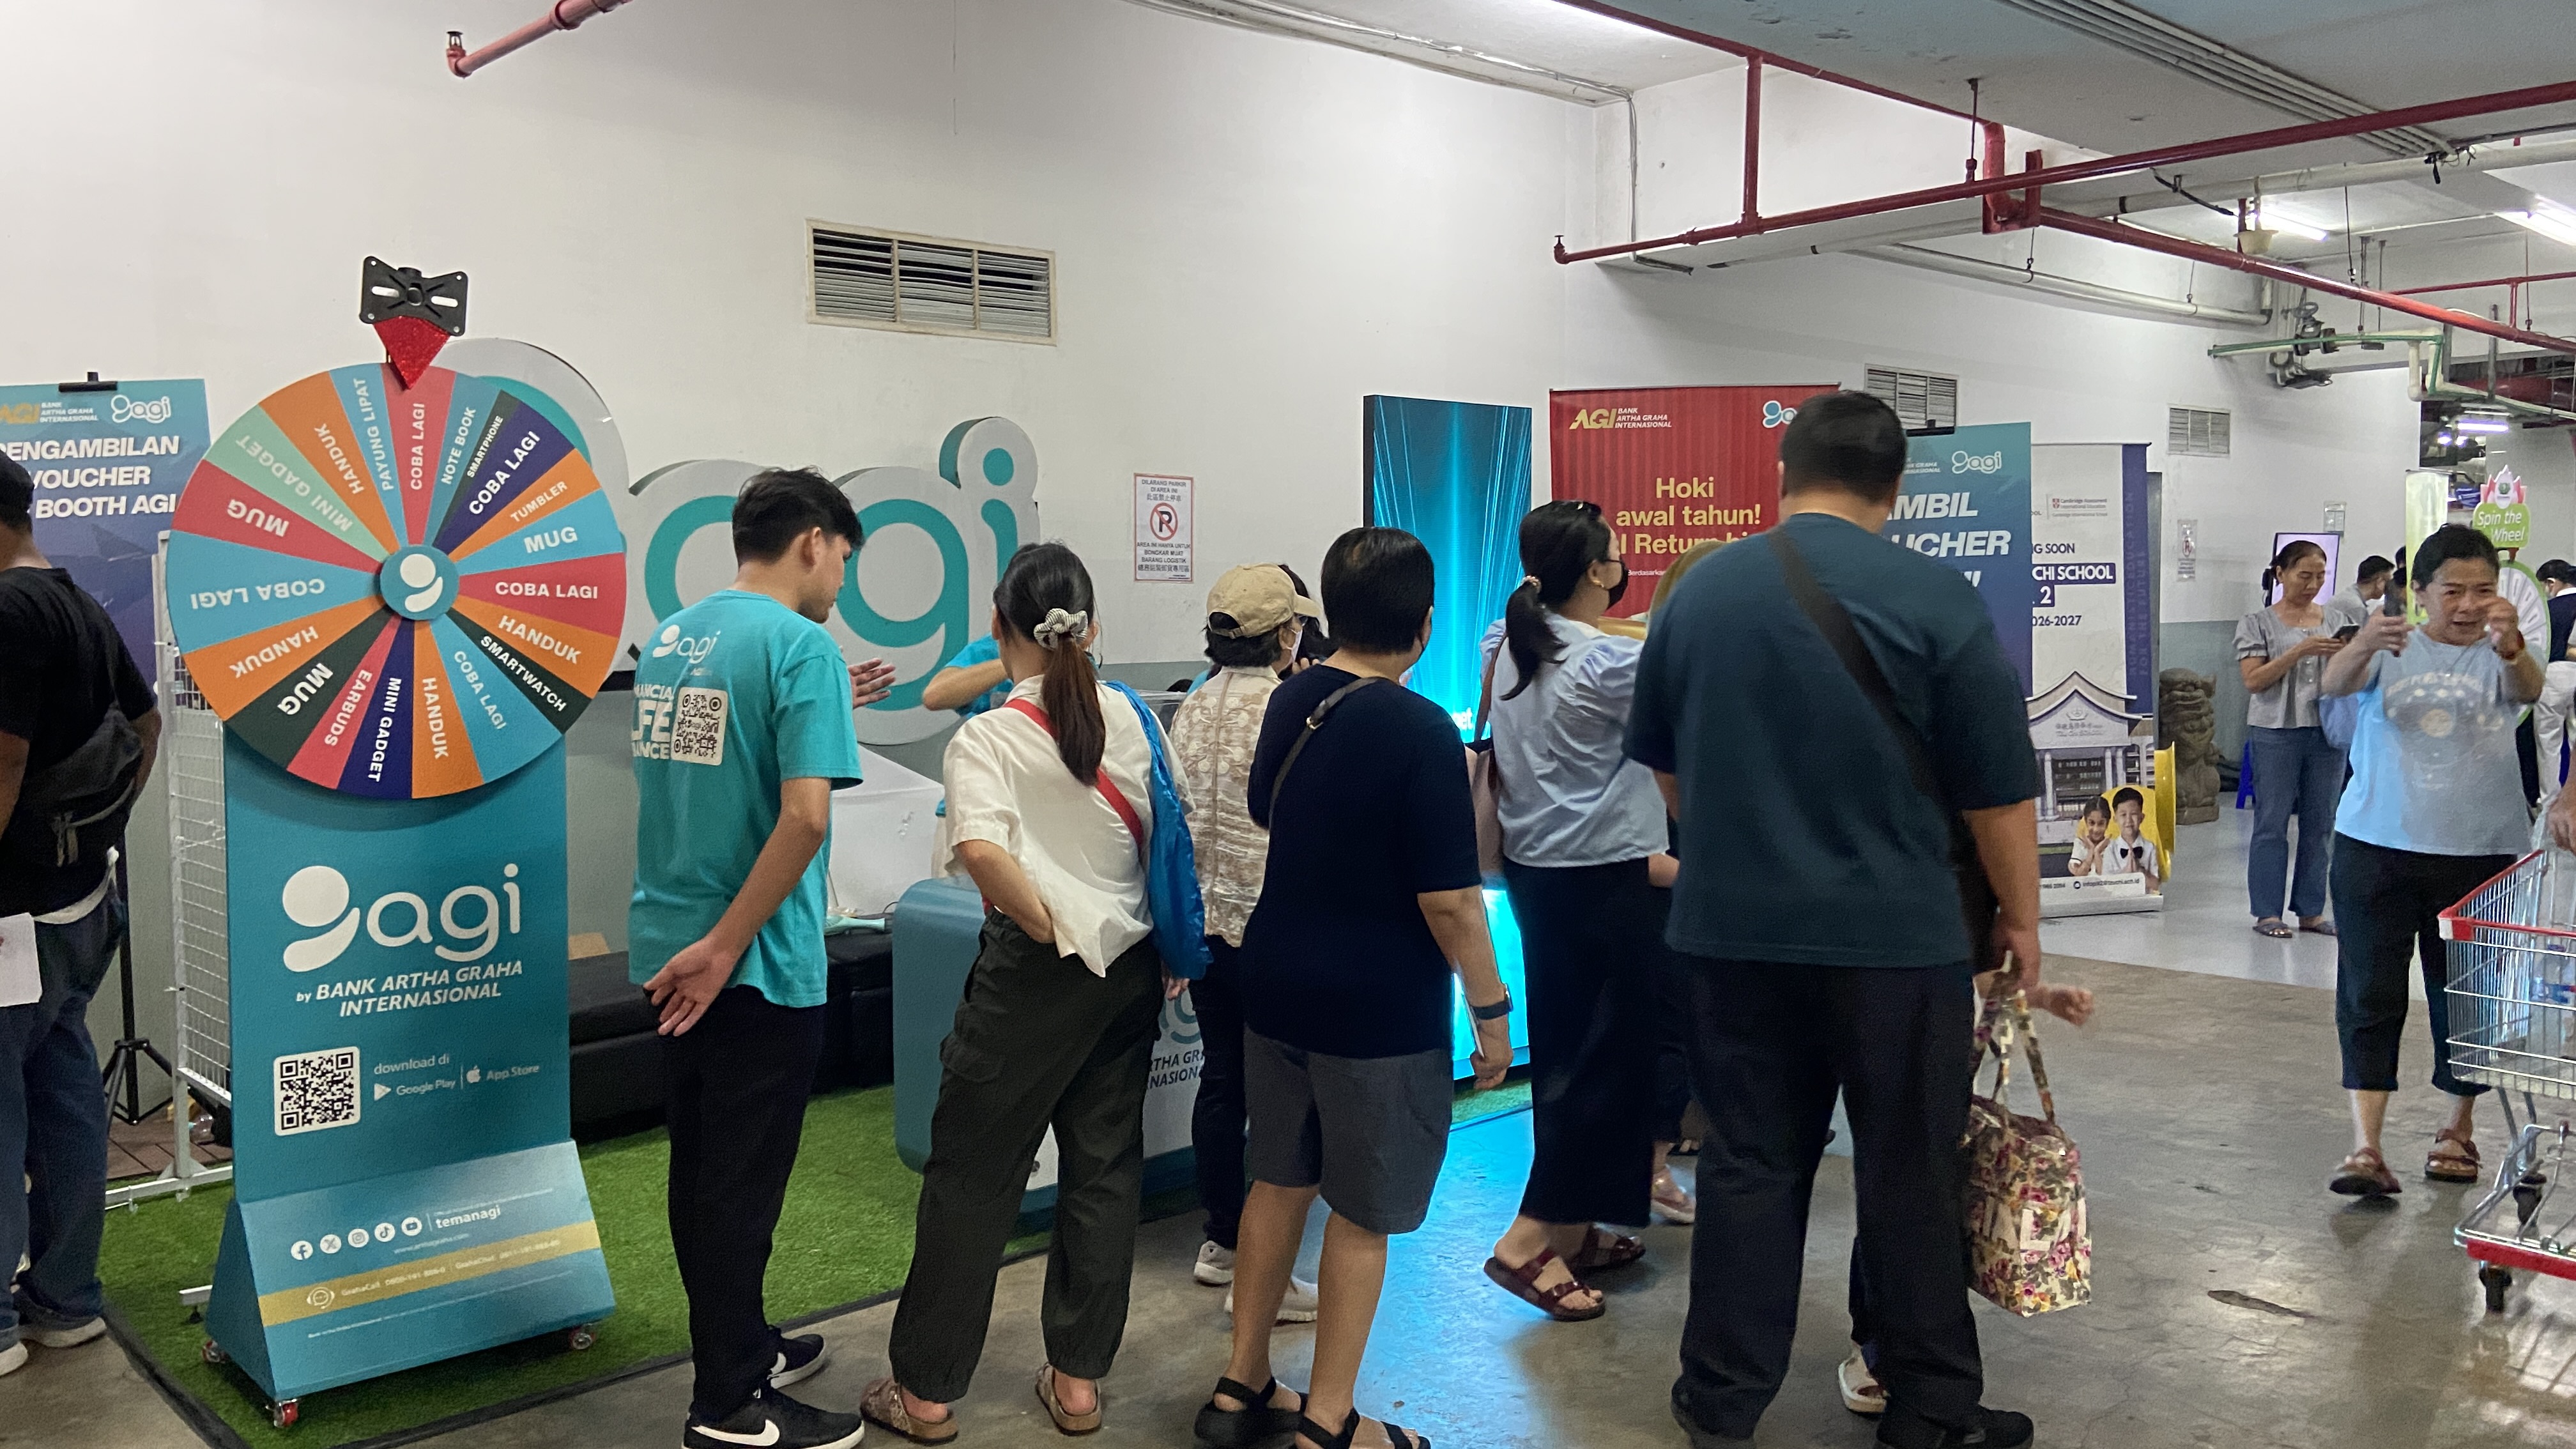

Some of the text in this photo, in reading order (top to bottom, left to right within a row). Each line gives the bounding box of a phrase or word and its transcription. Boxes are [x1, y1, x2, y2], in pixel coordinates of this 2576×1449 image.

[0, 403, 40, 425] AGI
[1569, 408, 1617, 429] AGI
[353, 378, 394, 491] PAYUNG LIPAT
[410, 402, 425, 491] COBA LAGI
[441, 406, 477, 485] NOTE BOOK
[466, 415, 503, 478] SMARTPHONE
[314, 423, 365, 494] HANDUK
[236, 434, 353, 532] MINI GADGET
[468, 431, 540, 515] COBA LAGI
[1655, 477, 1714, 498] Hoki
[35, 494, 177, 518] BOOTH AGI
[510, 480, 568, 523] TUMBLER
[1616, 504, 1761, 526] awal tahun!
[227, 498, 290, 537] MUG
[2478, 510, 2522, 528] Spin the
[524, 526, 578, 553] MUG
[1634, 533, 1719, 554] Retu
[1892, 530, 2011, 557] CHER
[2492, 527, 2525, 541] Wheel
[2045, 544, 2075, 553] SOON
[2032, 565, 2113, 581] CHI SCHOOL
[190, 578, 325, 610] COBA LAGI
[495, 581, 598, 599] COBA LAGI
[2040, 585, 2051, 604] 2
[2032, 615, 2082, 626] 026-2027
[228, 625, 319, 678] HANDUK
[498, 615, 582, 664] HANDUK
[480, 636, 567, 712] SMARTWATCH
[277, 663, 334, 716] MUG
[454, 651, 507, 730] COBA LAGI
[324, 670, 372, 747] EARBUDS
[422, 677, 449, 760] HANDUK
[368, 677, 402, 783] MINI GADGET
[296, 960, 523, 1002] by BANK ARTHA GRAHA
[340, 983, 502, 1016] INTERNASIONAL
[374, 1054, 449, 1075] download di
[1183, 1050, 1204, 1064] GR
[396, 1078, 456, 1095] Google Play
[486, 1064, 540, 1082] App Store
[1148, 1066, 1199, 1089] NASION
[436, 1205, 501, 1228] temanagi
